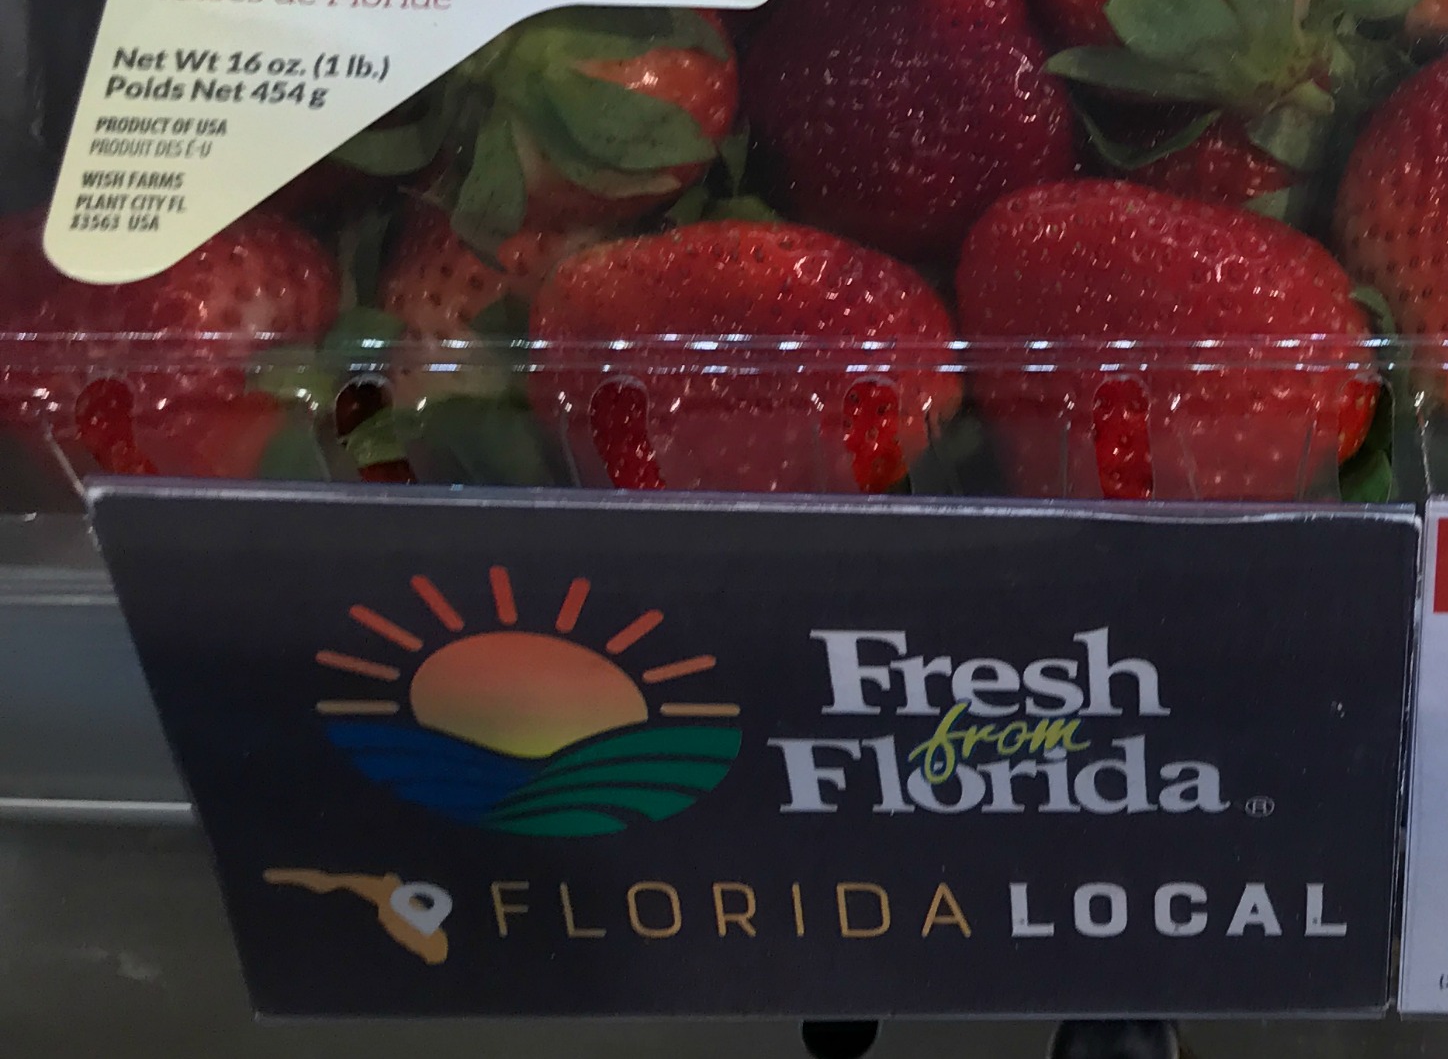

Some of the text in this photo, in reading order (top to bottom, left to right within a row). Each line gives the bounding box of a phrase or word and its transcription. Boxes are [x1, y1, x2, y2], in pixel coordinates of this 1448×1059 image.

[112, 48, 391, 83] Net Wt 16 oz. (1 lb.)
[105, 75, 326, 109] Poids Net 454 g
[95, 116, 228, 137] PRODUCT OF USA
[81, 170, 186, 190] WISH FARMS
[75, 194, 187, 213] PLANT CITY FL
[127, 214, 159, 231] USA
[810, 627, 1172, 718] Fresh
[908, 698, 1091, 783] from
[767, 734, 1231, 815] Florida
[492, 880, 1348, 938] FLORIDA LOCAL
